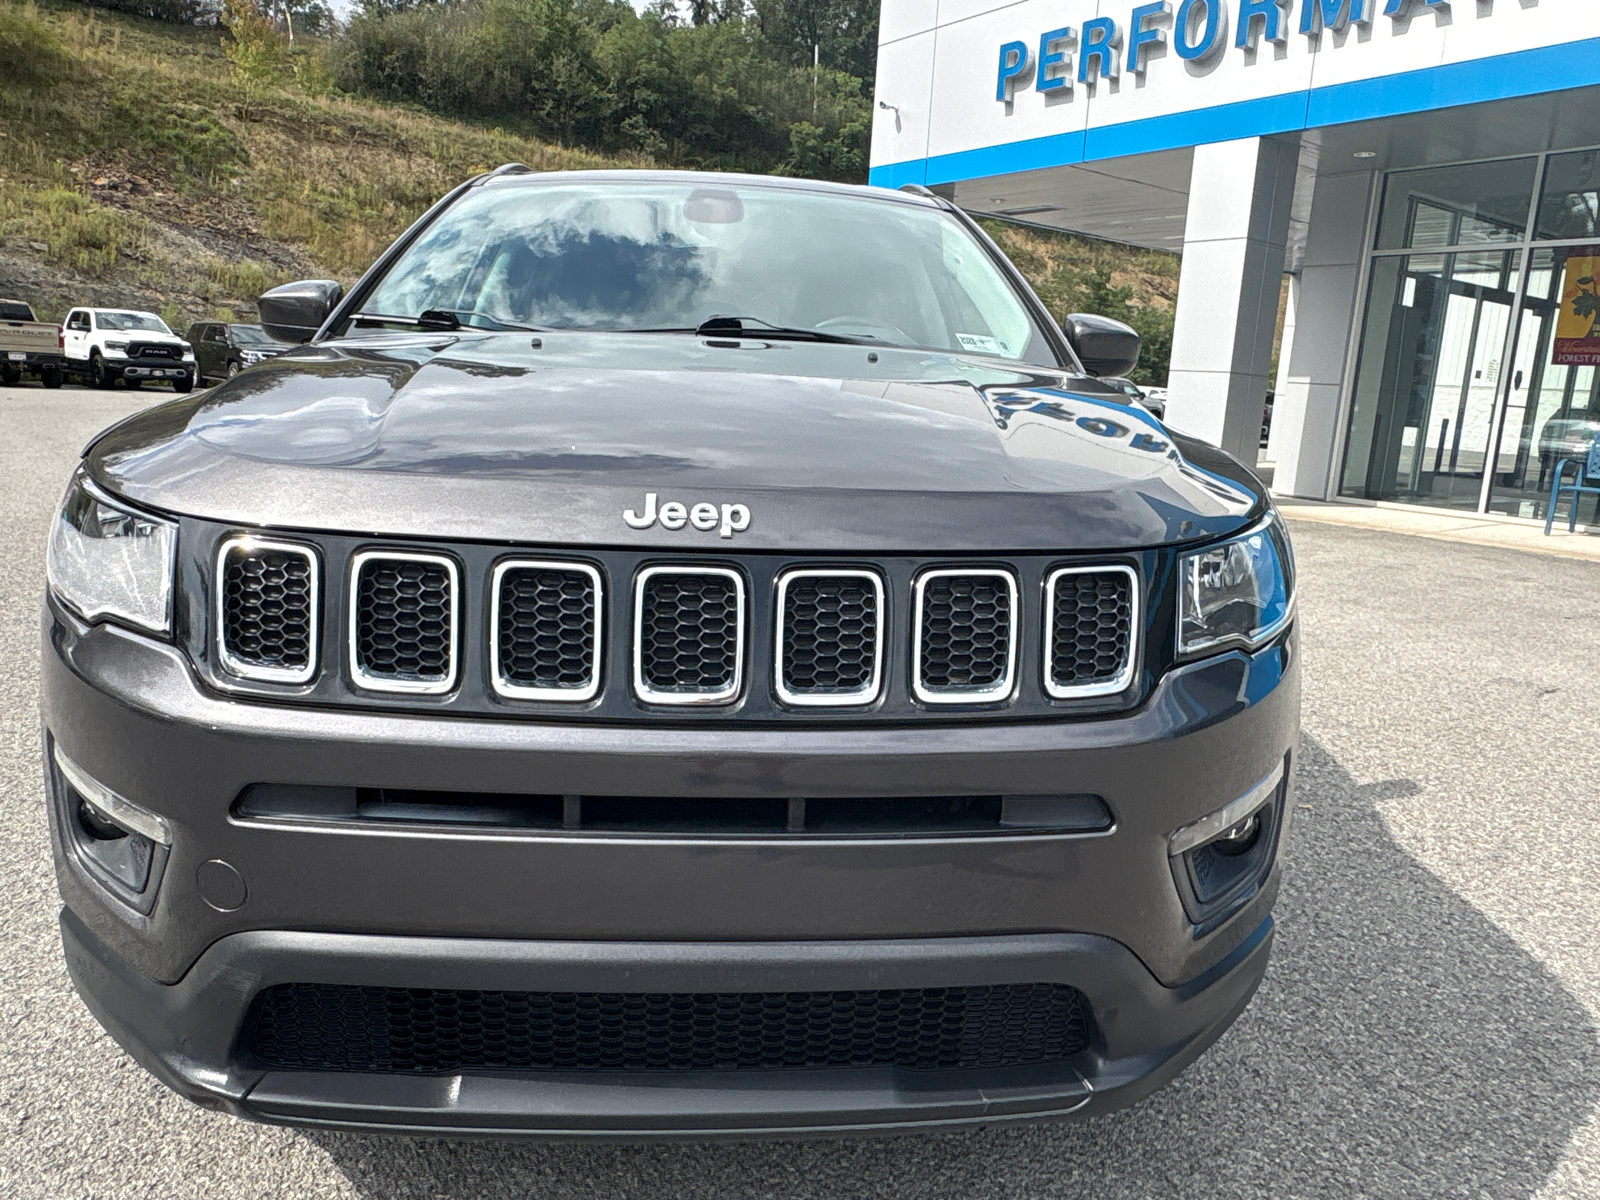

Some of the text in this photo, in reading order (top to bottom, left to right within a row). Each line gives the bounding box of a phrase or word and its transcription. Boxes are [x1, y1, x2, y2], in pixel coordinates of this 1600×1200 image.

[995, 0, 1451, 102] PERFOR
[1557, 354, 1591, 362] FOREST
[622, 492, 751, 539] Jeep
